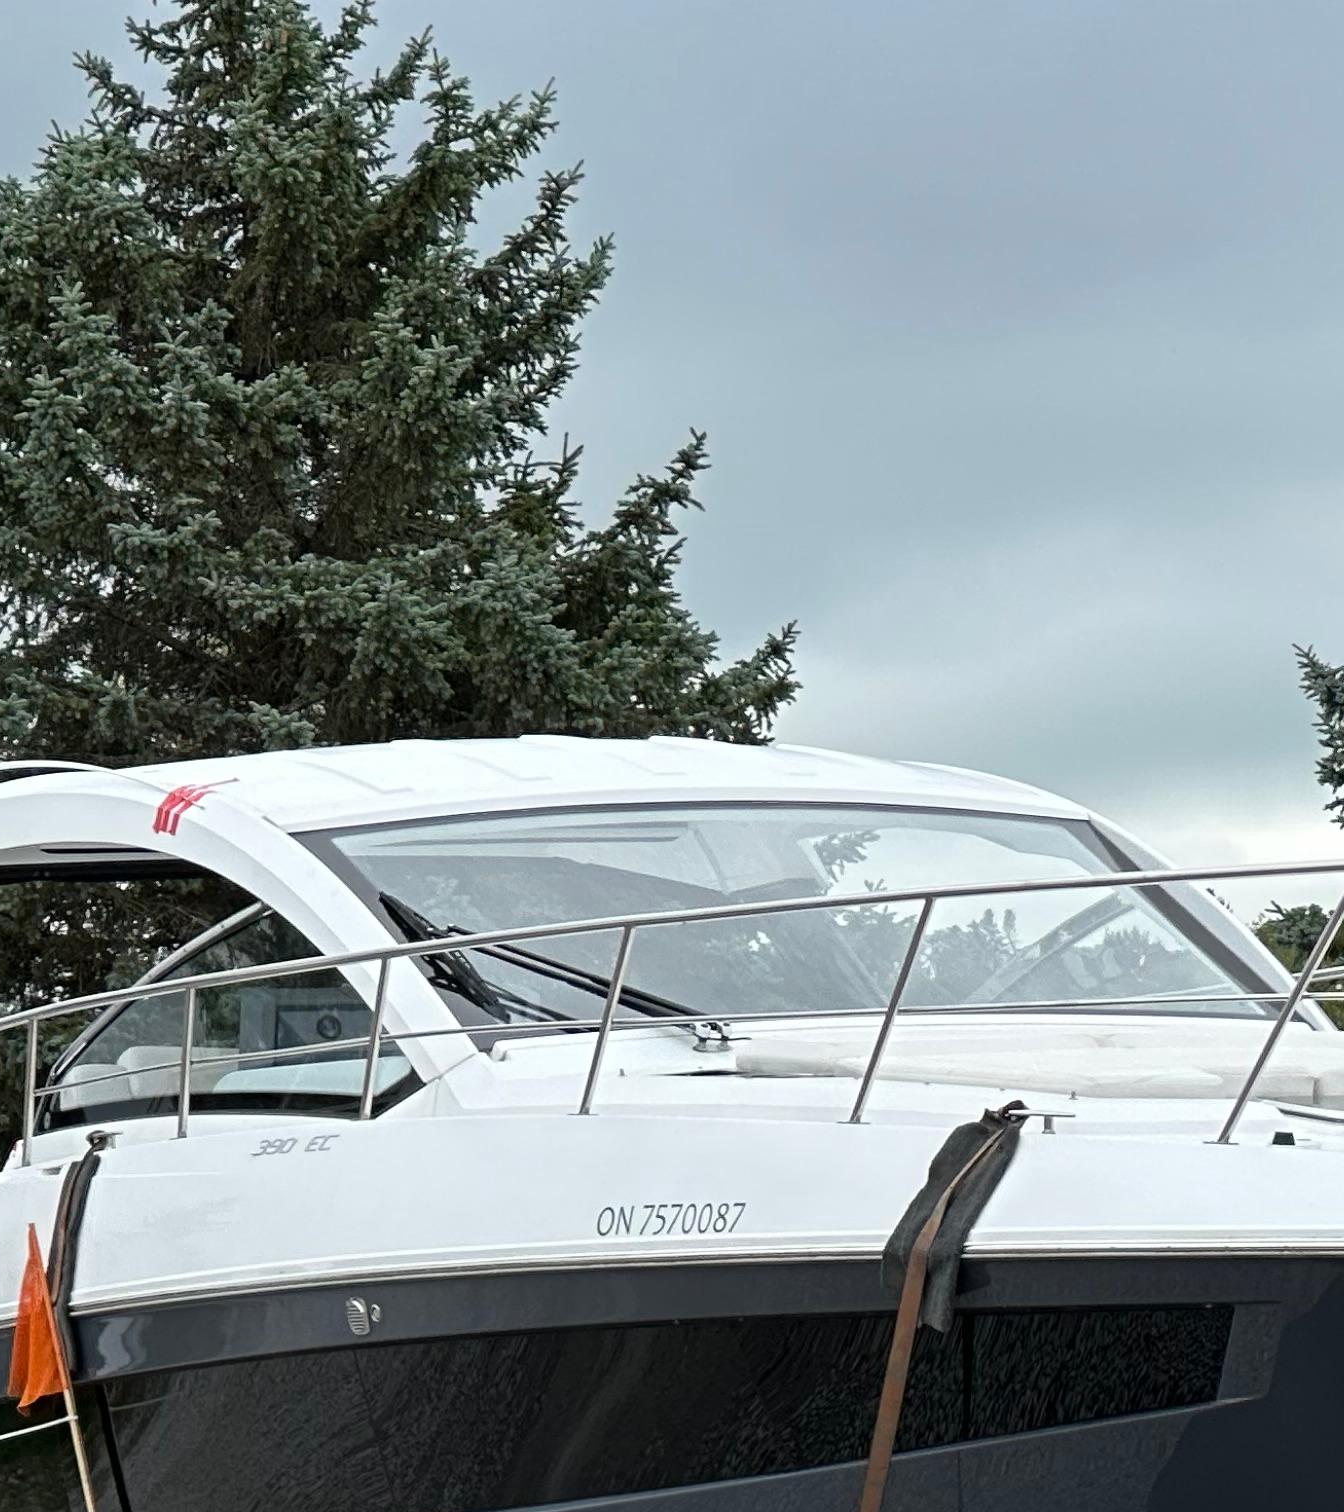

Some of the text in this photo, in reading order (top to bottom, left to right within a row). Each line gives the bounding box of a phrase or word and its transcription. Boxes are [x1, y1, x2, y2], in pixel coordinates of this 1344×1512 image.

[250, 1134, 341, 1157] 390 EC
[596, 1202, 747, 1236] ON 7570087
